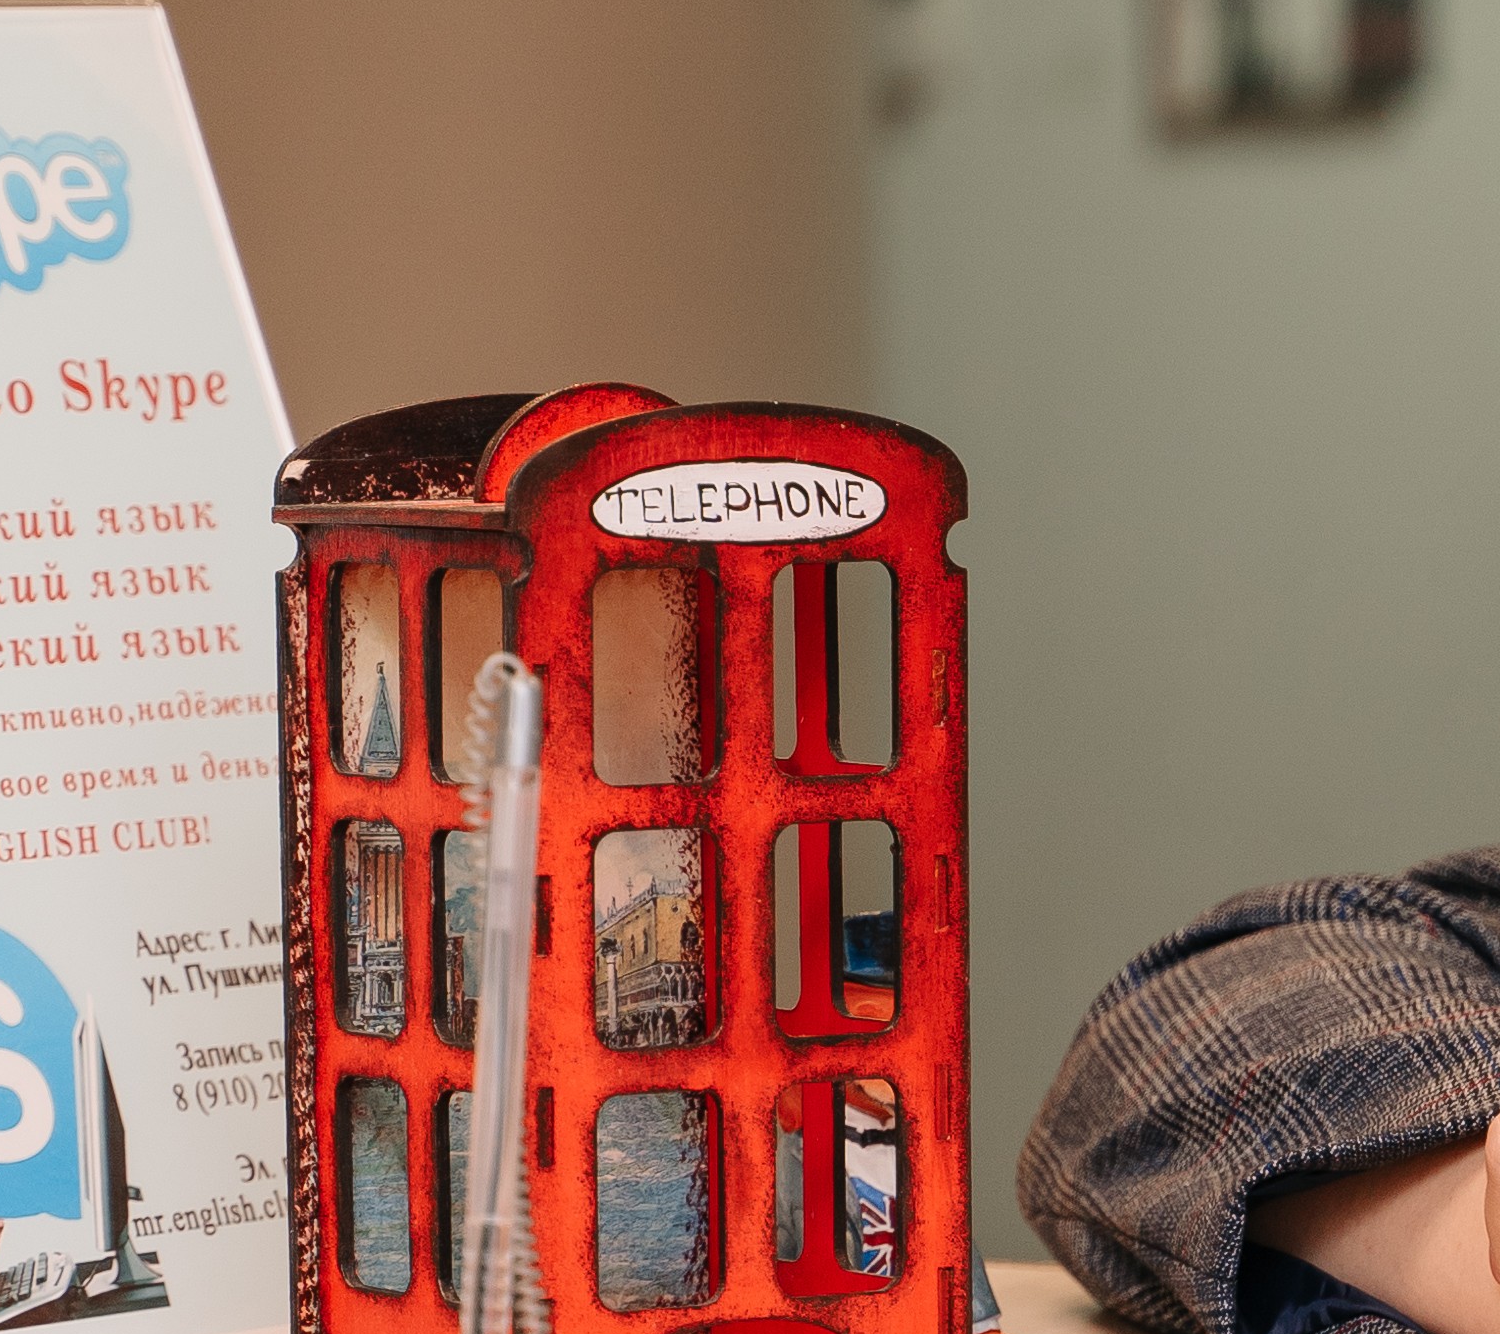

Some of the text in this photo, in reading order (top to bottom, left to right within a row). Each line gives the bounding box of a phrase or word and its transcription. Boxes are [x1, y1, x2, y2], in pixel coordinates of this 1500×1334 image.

[58, 358, 229, 422] Skype
[96, 499, 219, 535] язык
[605, 478, 866, 525] TELEPHONE
[90, 562, 213, 599] язык
[120, 621, 242, 659] язык
[62, 765, 158, 799] время
[172, 762, 190, 784] и
[112, 815, 212, 853] CLUB!
[137, 920, 282, 964] Адрес: г. Ли
[142, 975, 179, 1006] ул.
[176, 1042, 263, 1071] Запись
[173, 1083, 189, 1112] 8
[195, 1075, 258, 1116] (910)
[235, 1154, 276, 1183] Эл.
[132, 1190, 288, 1237] mr.english.cl
